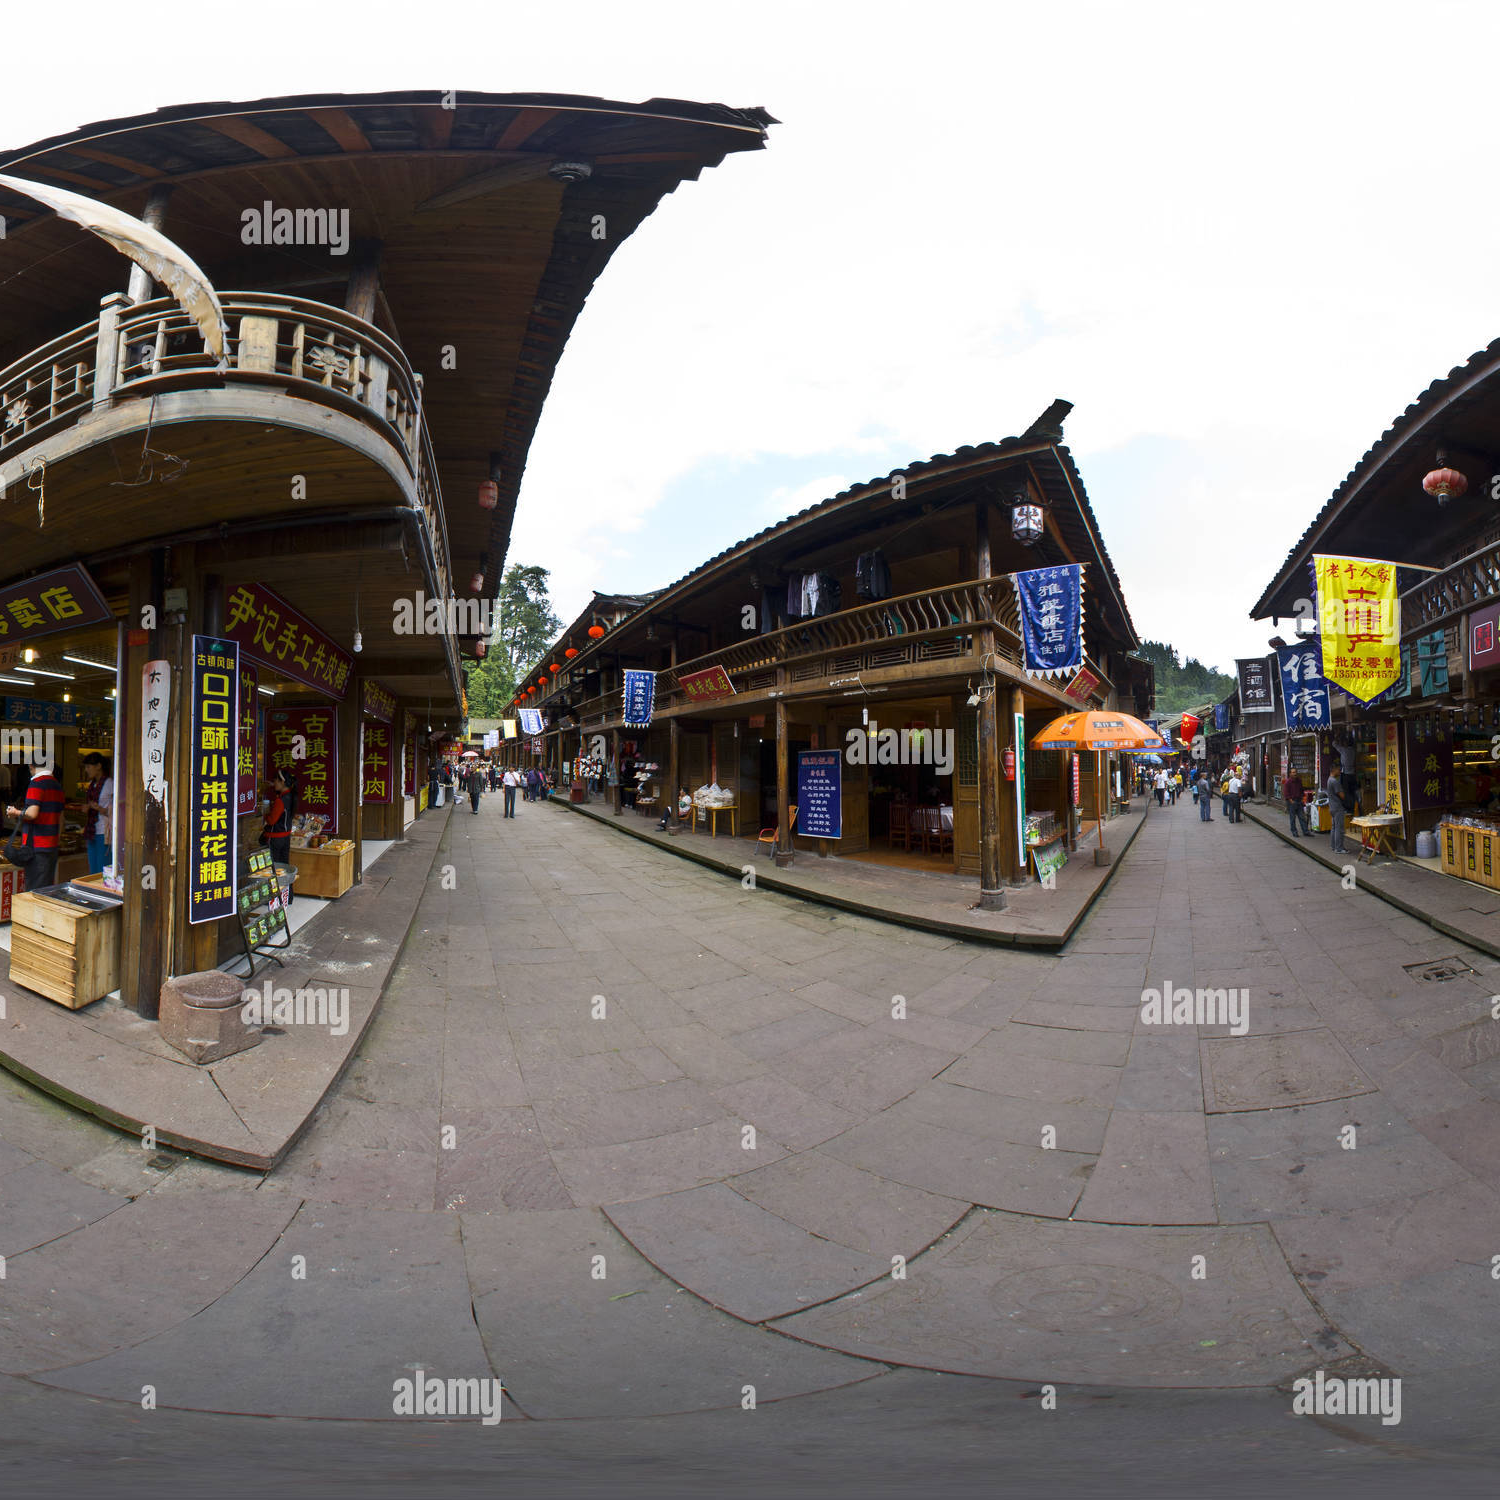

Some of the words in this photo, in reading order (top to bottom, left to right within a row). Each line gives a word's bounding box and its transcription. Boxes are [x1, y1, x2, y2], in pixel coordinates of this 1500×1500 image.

[225, 587, 349, 690] 尹记手工牛皮糖
[1040, 644, 1066, 655] 住宿
[197, 653, 235, 670] 古镇风味
[1335, 656, 1394, 669] 批发零售
[1283, 652, 1325, 720] 住宿
[11, 701, 74, 723] 尹记食品
[199, 672, 230, 885] 口口酥小米米花糖
[302, 714, 329, 805] 古镇名糕
